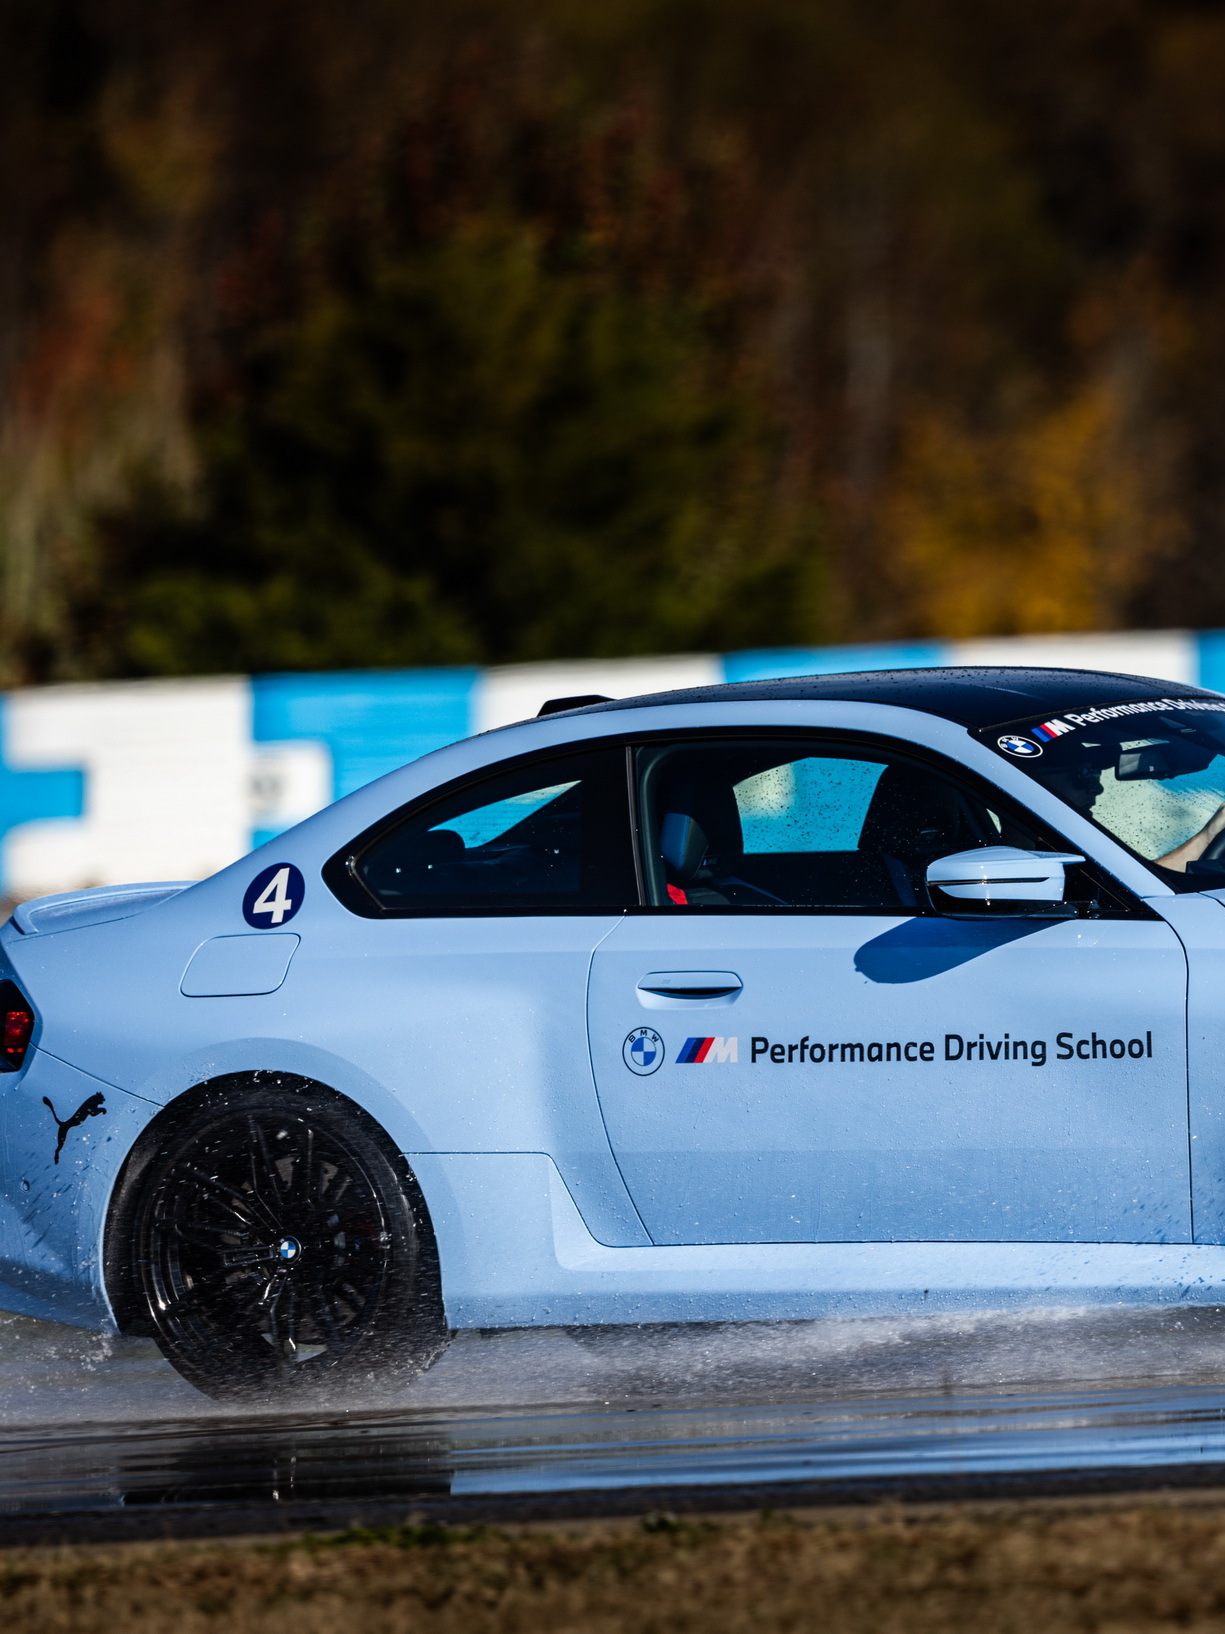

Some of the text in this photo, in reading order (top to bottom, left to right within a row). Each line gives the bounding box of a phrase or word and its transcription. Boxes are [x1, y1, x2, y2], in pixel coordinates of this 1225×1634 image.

[1063, 700, 1175, 727] Performance
[252, 866, 292, 924] 4
[750, 1035, 935, 1064] Performance
[944, 1033, 1047, 1067] Driving
[1055, 1030, 1153, 1060] School
